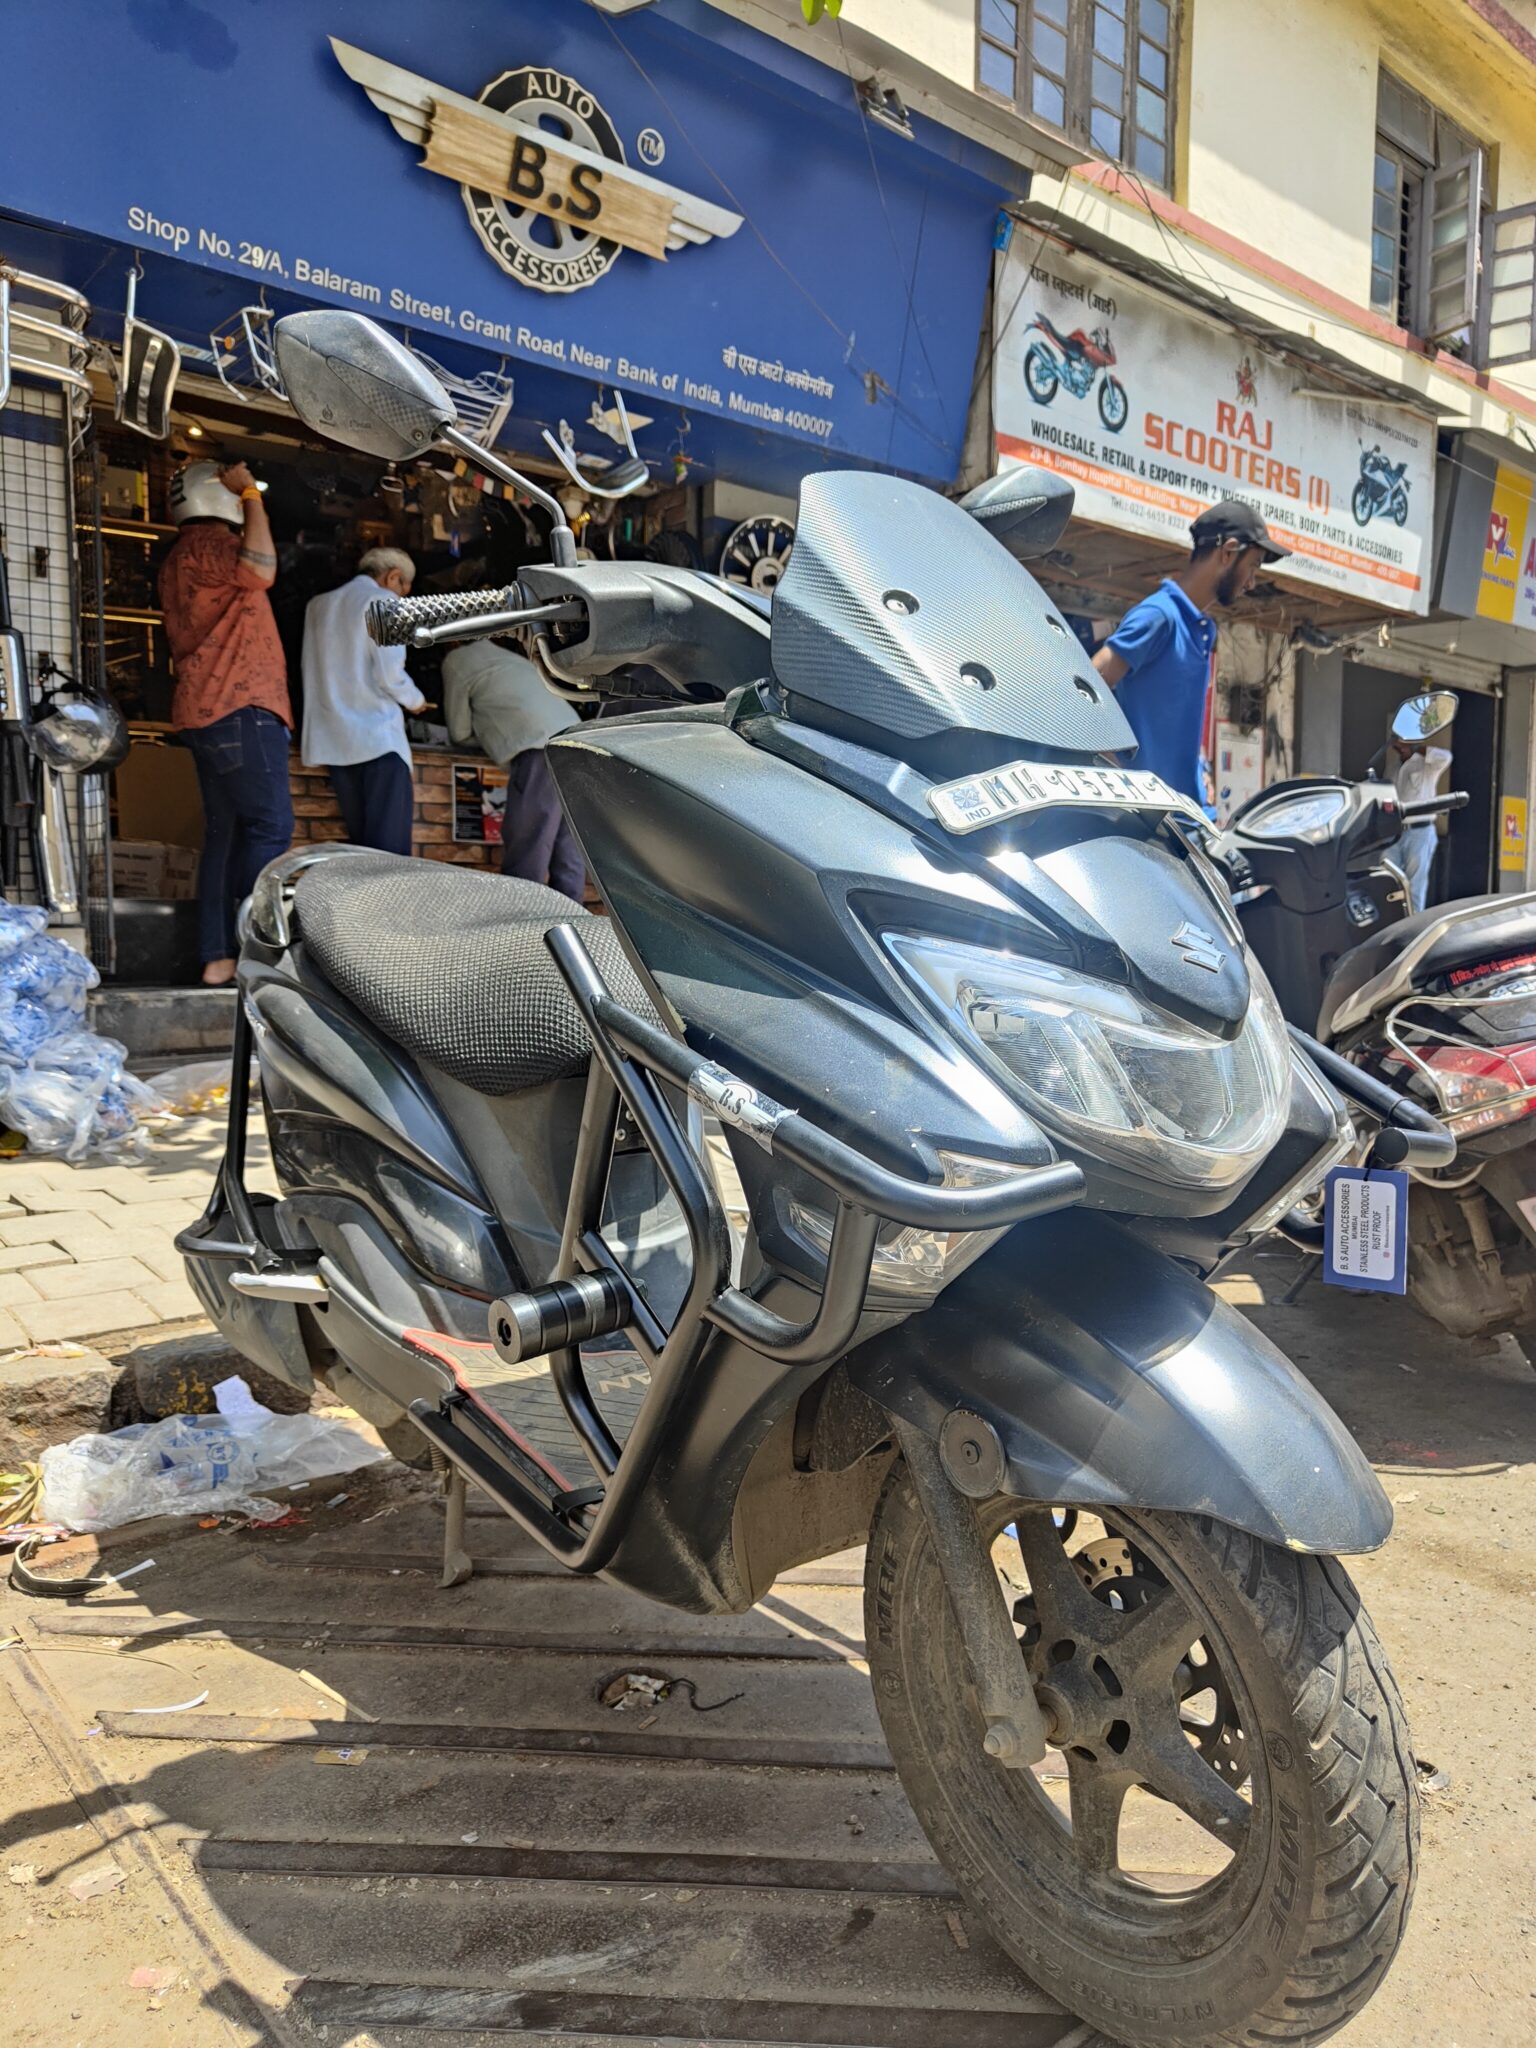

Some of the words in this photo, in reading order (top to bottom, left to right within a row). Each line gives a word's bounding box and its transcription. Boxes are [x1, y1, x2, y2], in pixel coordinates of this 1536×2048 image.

[526, 72, 594, 119] AUTO
[508, 134, 603, 221] B.S
[477, 206, 608, 286] ACCESSOREIS
[1029, 263, 1049, 287] राज
[127, 206, 190, 251] Shop
[294, 258, 381, 304] Balaram
[389, 287, 456, 329] Street,
[459, 310, 511, 344] Grant
[516, 326, 567, 361] Road,
[570, 343, 611, 372] Near
[616, 357, 658, 388] Bank
[661, 371, 678, 393] of
[684, 377, 723, 408] India,
[728, 391, 785, 424] Mumbai
[784, 409, 834, 438] 400007
[1216, 400, 1273, 451] RAJ
[1144, 412, 1301, 500] SCOOTERS
[1309, 475, 1330, 516] (I)
[1031, 418, 1099, 461] WHOLESALE,
[1101, 446, 1136, 473] RETAIL
[1139, 460, 1146, 477] &
[1149, 462, 1188, 489] EXPORT
[1190, 477, 1209, 497] FOR
[1211, 484, 1217, 500] 2
[1264, 501, 1298, 530] SPARES,
[1299, 516, 1320, 536] BODY
[1322, 523, 1346, 545] PARTS
[1348, 533, 1353, 547] &
[1355, 537, 1403, 564] ACCESSORIES
[965, 807, 991, 822] IND
[718, 1087, 745, 1115] B.S
[1341, 1183, 1350, 1234] ACCESSORIES
[1360, 1184, 1370, 1218] PRODUCTS
[1372, 1210, 1382, 1233] PROOF
[1359, 1219, 1369, 1240] STEEL
[1372, 1233, 1381, 1250] RUST
[1359, 1241, 1369, 1272] STAINLESS
[1265, 1794, 1301, 1953] MRF
